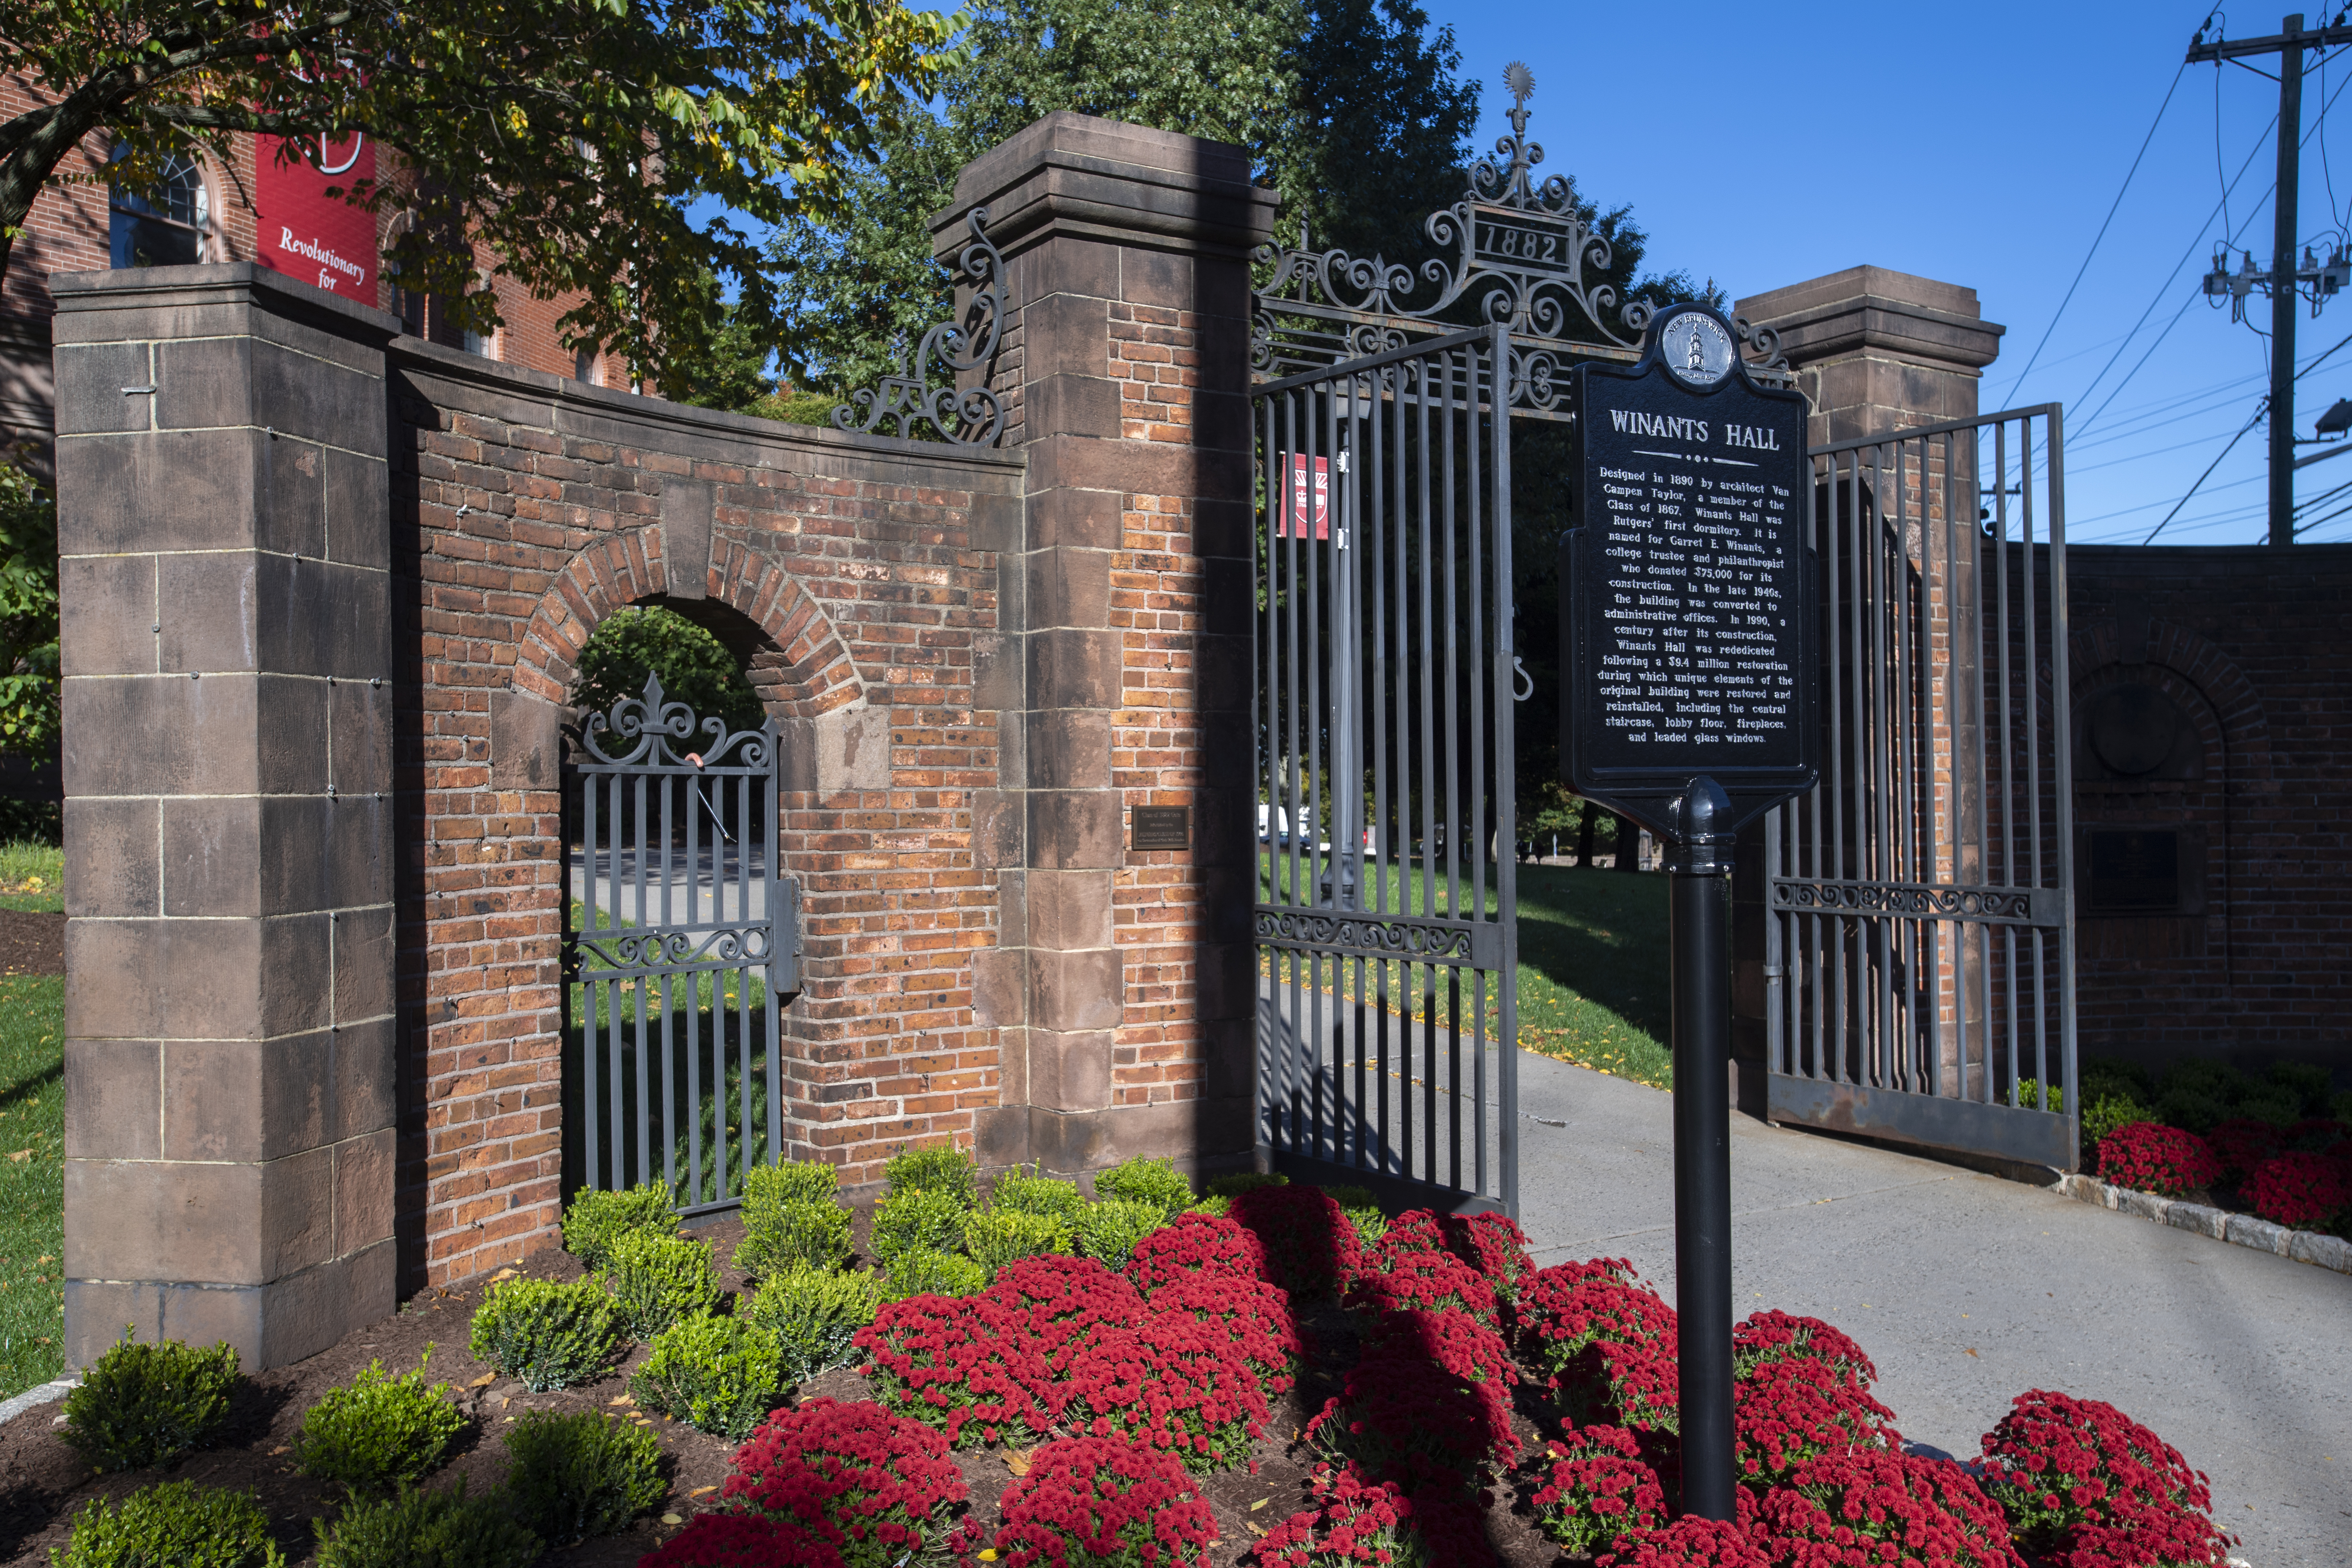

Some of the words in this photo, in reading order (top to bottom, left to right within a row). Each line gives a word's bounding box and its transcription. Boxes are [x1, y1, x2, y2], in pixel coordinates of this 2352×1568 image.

[1484, 226, 1556, 262] 1882
[278, 226, 365, 286] Revolutionary
[318, 268, 337, 290] for
[1667, 318, 1682, 336] NEW
[1684, 314, 1726, 344] BRUNSWICK
[1678, 370, 1693, 379] History
[1609, 409, 1708, 442] WINANTS
[1724, 424, 1780, 451] HALL
[1599, 466, 1645, 481] Designed
[1653, 472, 1663, 483] in
[1670, 474, 1693, 486] 1890
[1701, 477, 1713, 490] by
[1720, 482, 1764, 494] architect
[1772, 485, 1789, 497] Van
[1603, 483, 1643, 498] Campen
[1650, 488, 1686, 502] Taylor,
[1697, 494, 1704, 502] a
[1710, 495, 1747, 506] member
[1751, 498, 1763, 508] of
[1768, 499, 1785, 510] the
[1606, 499, 1633, 511] Class
[1639, 503, 1650, 512] of
[1658, 504, 1682, 517] 1867,
[1694, 507, 1732, 520] Winants
[1739, 511, 1759, 523] Hall
[1765, 516, 1783, 525] was
[1613, 515, 1654, 529] Rutgers'
[1664, 520, 1686, 531] first
[1693, 523, 1742, 537] dormitory.
[1753, 528, 1762, 538] It
[1768, 529, 1777, 539] is
[1608, 533, 1641, 542] named
[1648, 534, 1663, 544] for
[1669, 536, 1703, 547] Garret
[1710, 539, 1719, 549] E.
[1726, 540, 1765, 554] Winants,
[1605, 547, 1642, 560] college
[1648, 550, 1685, 561] trustee
[1693, 553, 1710, 563] and
[1718, 555, 1784, 570] philanthropist
[1620, 563, 1641, 573] who
[1647, 564, 1687, 577] donated
[1693, 566, 1733, 580] $75,000
[1739, 571, 1753, 581] for
[1760, 572, 1772, 583] its
[1608, 579, 1675, 591] construction.
[1687, 582, 1698, 593] In
[1704, 583, 1720, 594] the
[1727, 585, 1747, 596] late
[1753, 586, 1782, 599] 1940s,
[1614, 593, 1631, 604] the
[1639, 594, 1680, 609] building
[1687, 599, 1706, 607] was
[1712, 601, 1760, 610] converted
[1767, 602, 1778, 611] to
[1604, 608, 1677, 621] administrative
[1682, 612, 1718, 623] offices.
[1730, 614, 1740, 624] In
[1746, 615, 1770, 627] 1990,
[1614, 625, 1654, 637] century
[1662, 626, 1688, 637] after
[1696, 628, 1709, 638] its
[1715, 630, 1777, 642] construction,
[1616, 639, 1656, 651] Winants
[1664, 642, 1685, 653] Hall
[1694, 645, 1712, 653] was
[1719, 645, 1775, 656] rededicated
[1602, 655, 1648, 669] following
[1655, 658, 1662, 667] a
[1668, 656, 1690, 667] $9.4
[1697, 658, 1730, 669] million
[1736, 660, 1788, 671] restoration
[1597, 670, 1631, 683] during
[1638, 671, 1668, 682] which
[1674, 672, 1707, 685] unique
[1714, 673, 1754, 684] elements
[1760, 675, 1771, 685] of
[1777, 675, 1793, 686] the
[1599, 685, 1641, 698] original
[1648, 686, 1689, 700] building
[1696, 689, 1720, 697] were
[1726, 689, 1767, 699] restored
[1774, 690, 1791, 699] and
[1606, 701, 1664, 713] reinstalled,
[1676, 702, 1721, 715] including
[1728, 703, 1745, 713] the
[1752, 704, 1786, 714] central
[1605, 716, 1655, 728] staircase,
[1665, 716, 1693, 729] lobby
[1700, 718, 1727, 729] floor,
[1737, 718, 1786, 730] fireplaces,
[1628, 732, 1647, 742] and
[1654, 732, 1687, 742] leaded
[1693, 732, 1719, 745] glass
[1725, 733, 1766, 743] windows.
